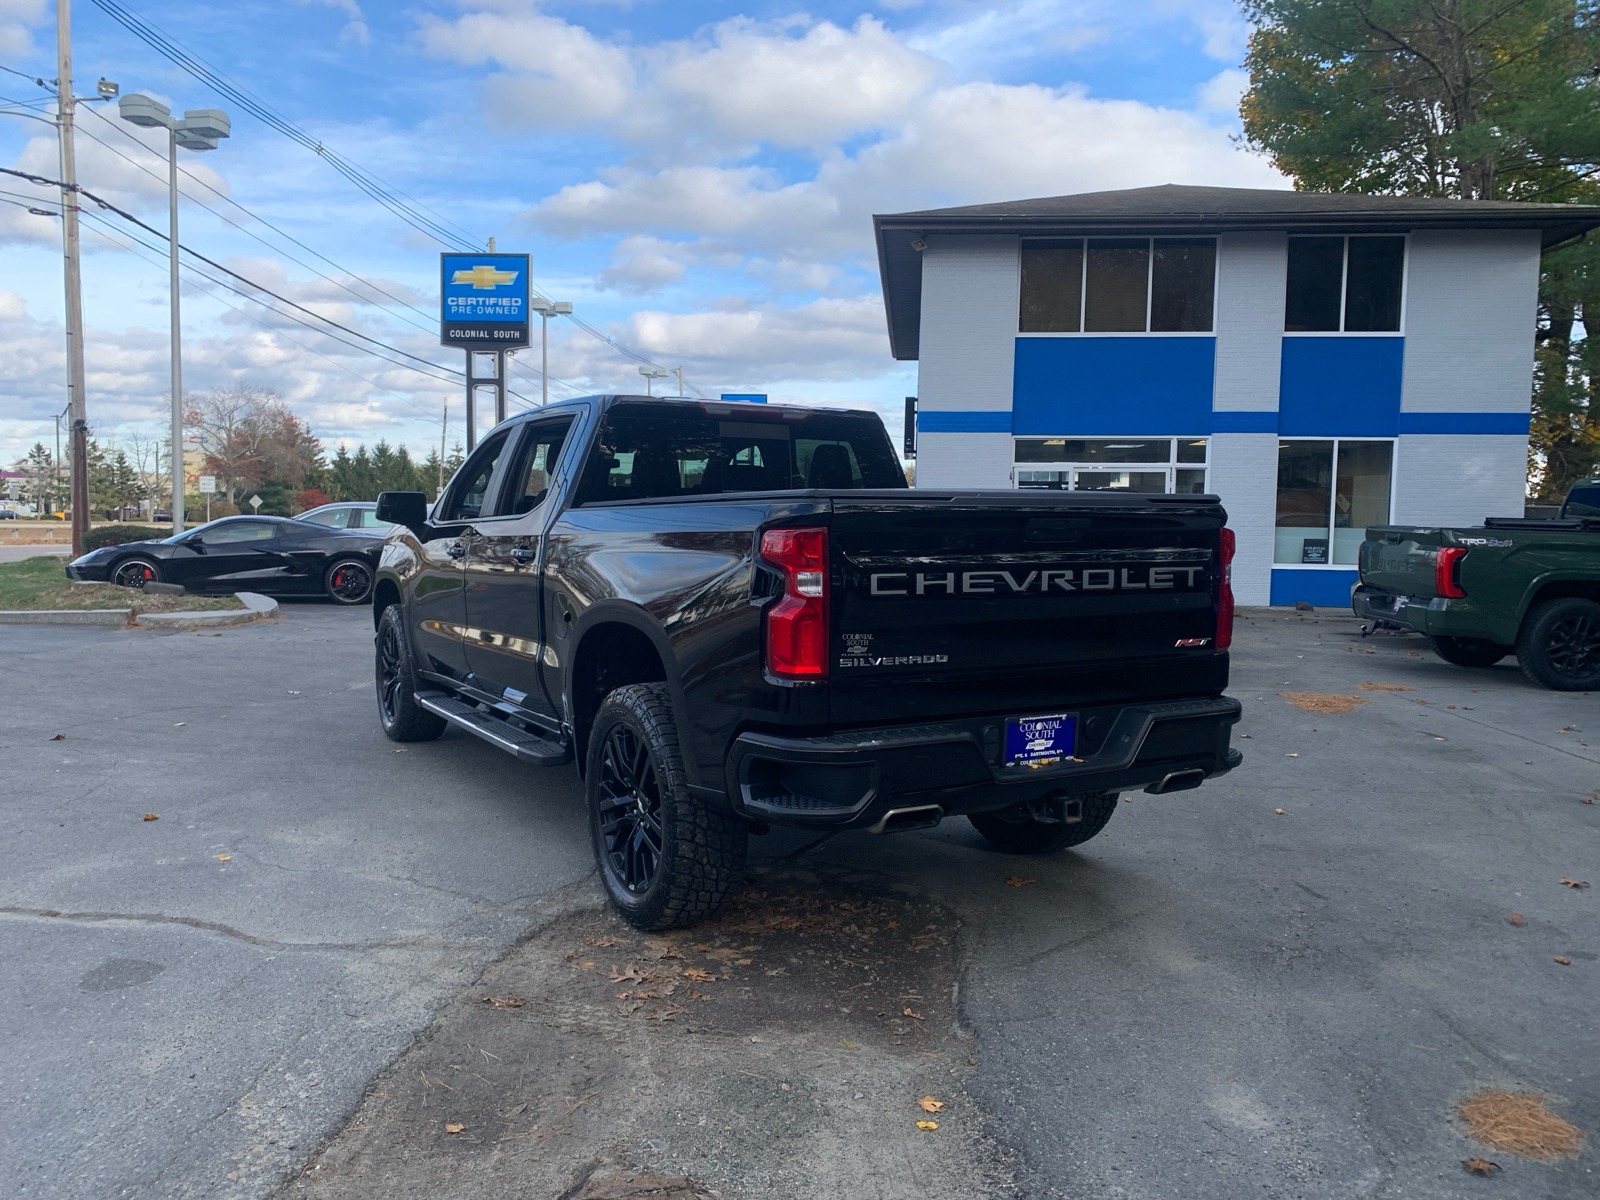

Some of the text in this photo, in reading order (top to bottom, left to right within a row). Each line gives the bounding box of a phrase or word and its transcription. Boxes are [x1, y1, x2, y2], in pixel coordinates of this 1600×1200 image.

[447, 297, 522, 306] CERTIFIED
[451, 306, 518, 315] PRE-OWNED
[449, 330, 520, 338] COLONIAL SOUTH
[1458, 538, 1487, 546] TRD
[870, 566, 1204, 596] CHEVROLET
[1174, 638, 1212, 648] RST
[839, 655, 948, 667] SILVERADO
[1020, 720, 1062, 732] COLONIAL
[1025, 729, 1055, 740] SOUTH
